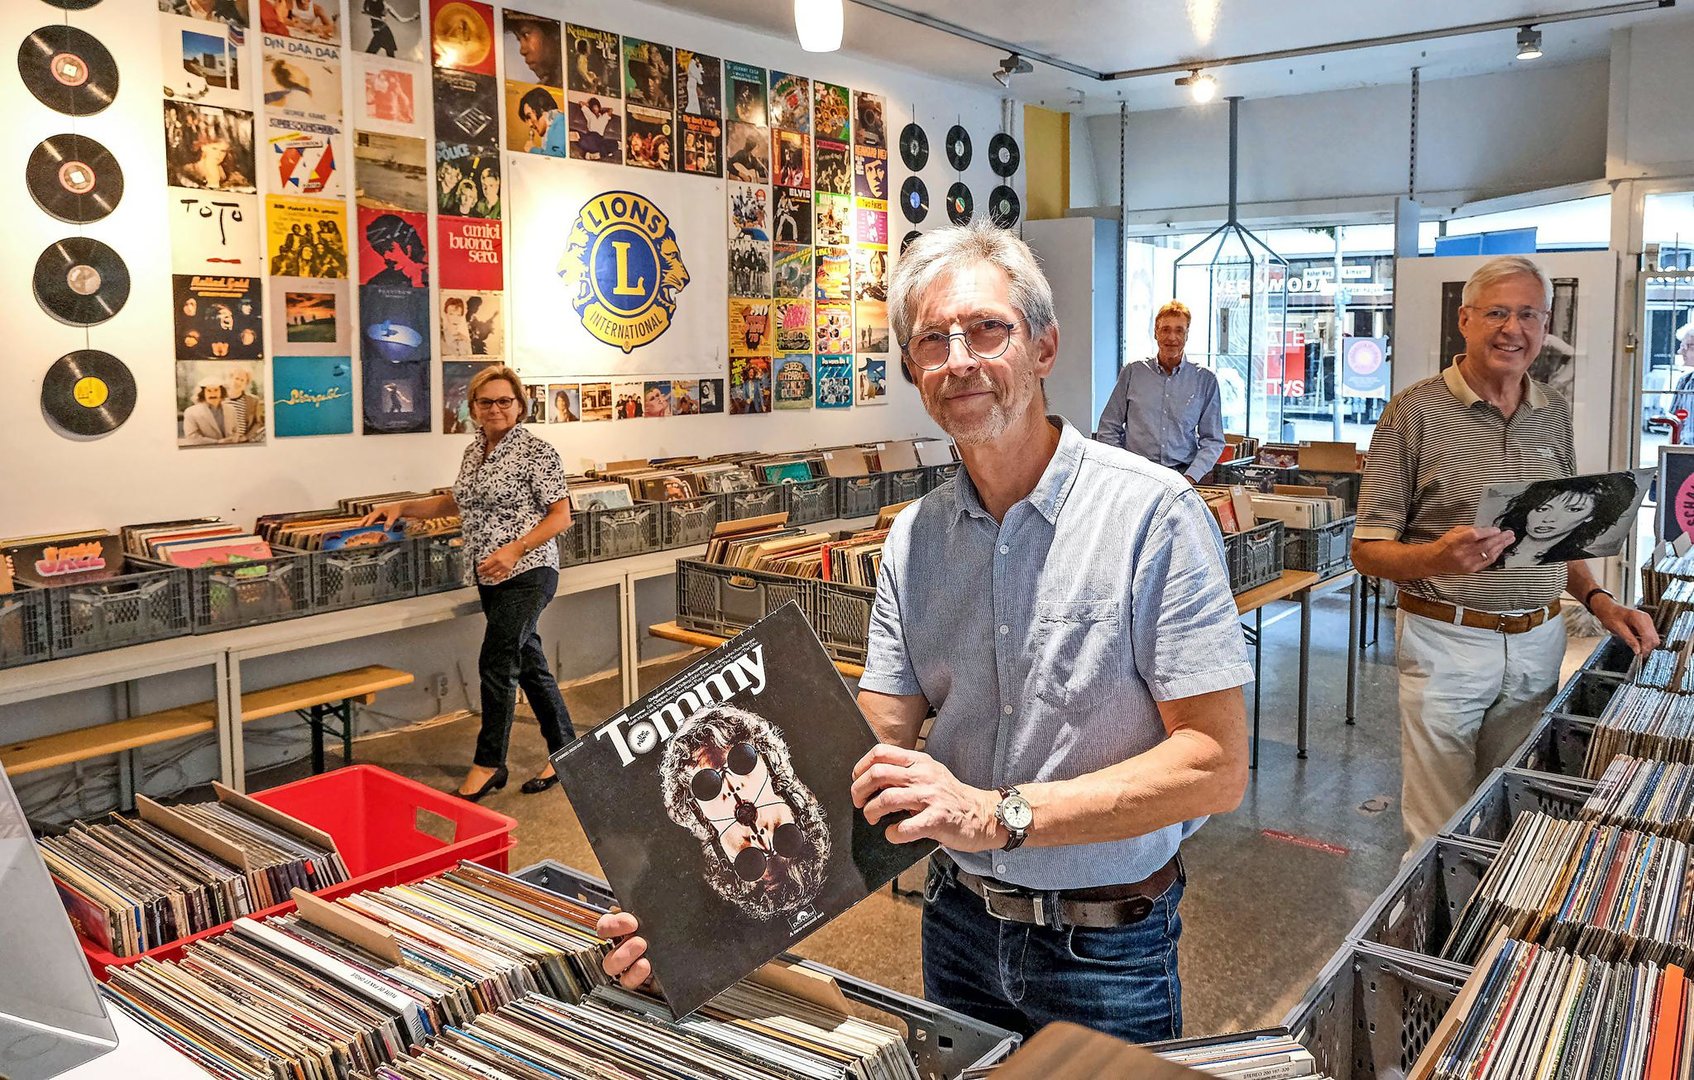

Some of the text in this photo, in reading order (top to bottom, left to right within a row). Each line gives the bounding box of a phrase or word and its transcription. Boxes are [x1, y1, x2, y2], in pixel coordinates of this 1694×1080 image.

[263, 36, 340, 60] DIN DAA DAA
[437, 143, 470, 162] POLICE
[789, 188, 811, 198] ELVIS
[587, 197, 661, 234] LIONS
[450, 232, 493, 250] buona
[463, 223, 500, 240] amici
[469, 250, 498, 264] sera
[612, 241, 646, 296] L
[1268, 278, 1328, 293] MODA
[589, 310, 663, 340] INTERNATIONAL
[596, 643, 766, 767] Tommy
